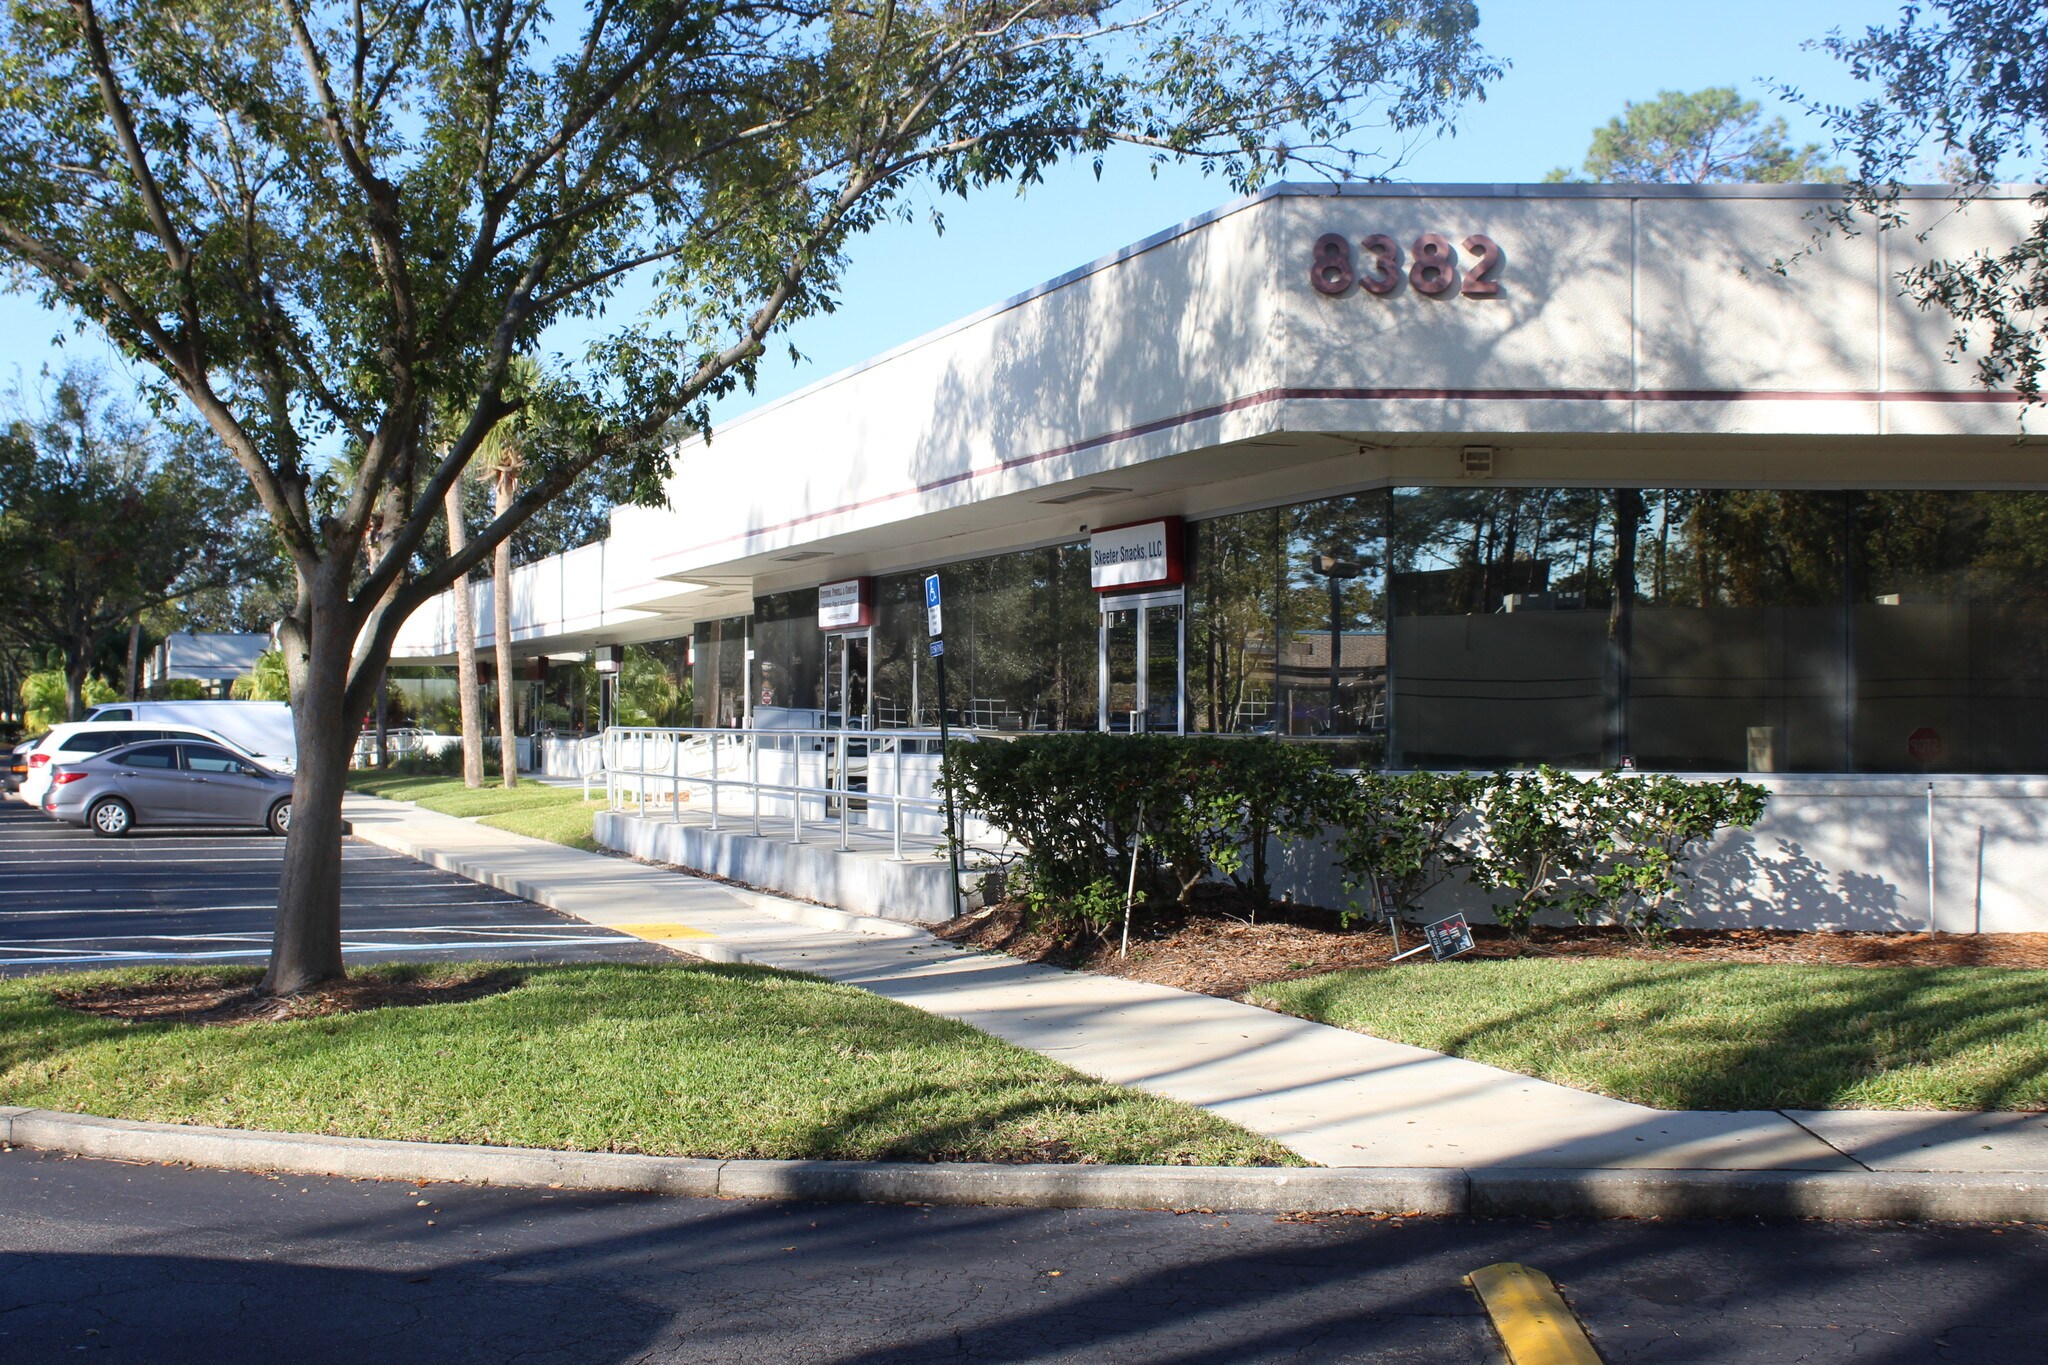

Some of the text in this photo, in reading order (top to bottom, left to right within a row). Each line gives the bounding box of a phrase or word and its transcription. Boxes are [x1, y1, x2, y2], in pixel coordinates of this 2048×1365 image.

[1310, 233, 1500, 294] 8382
[1094, 540, 1162, 566] Skeeter Snacks, LLC
